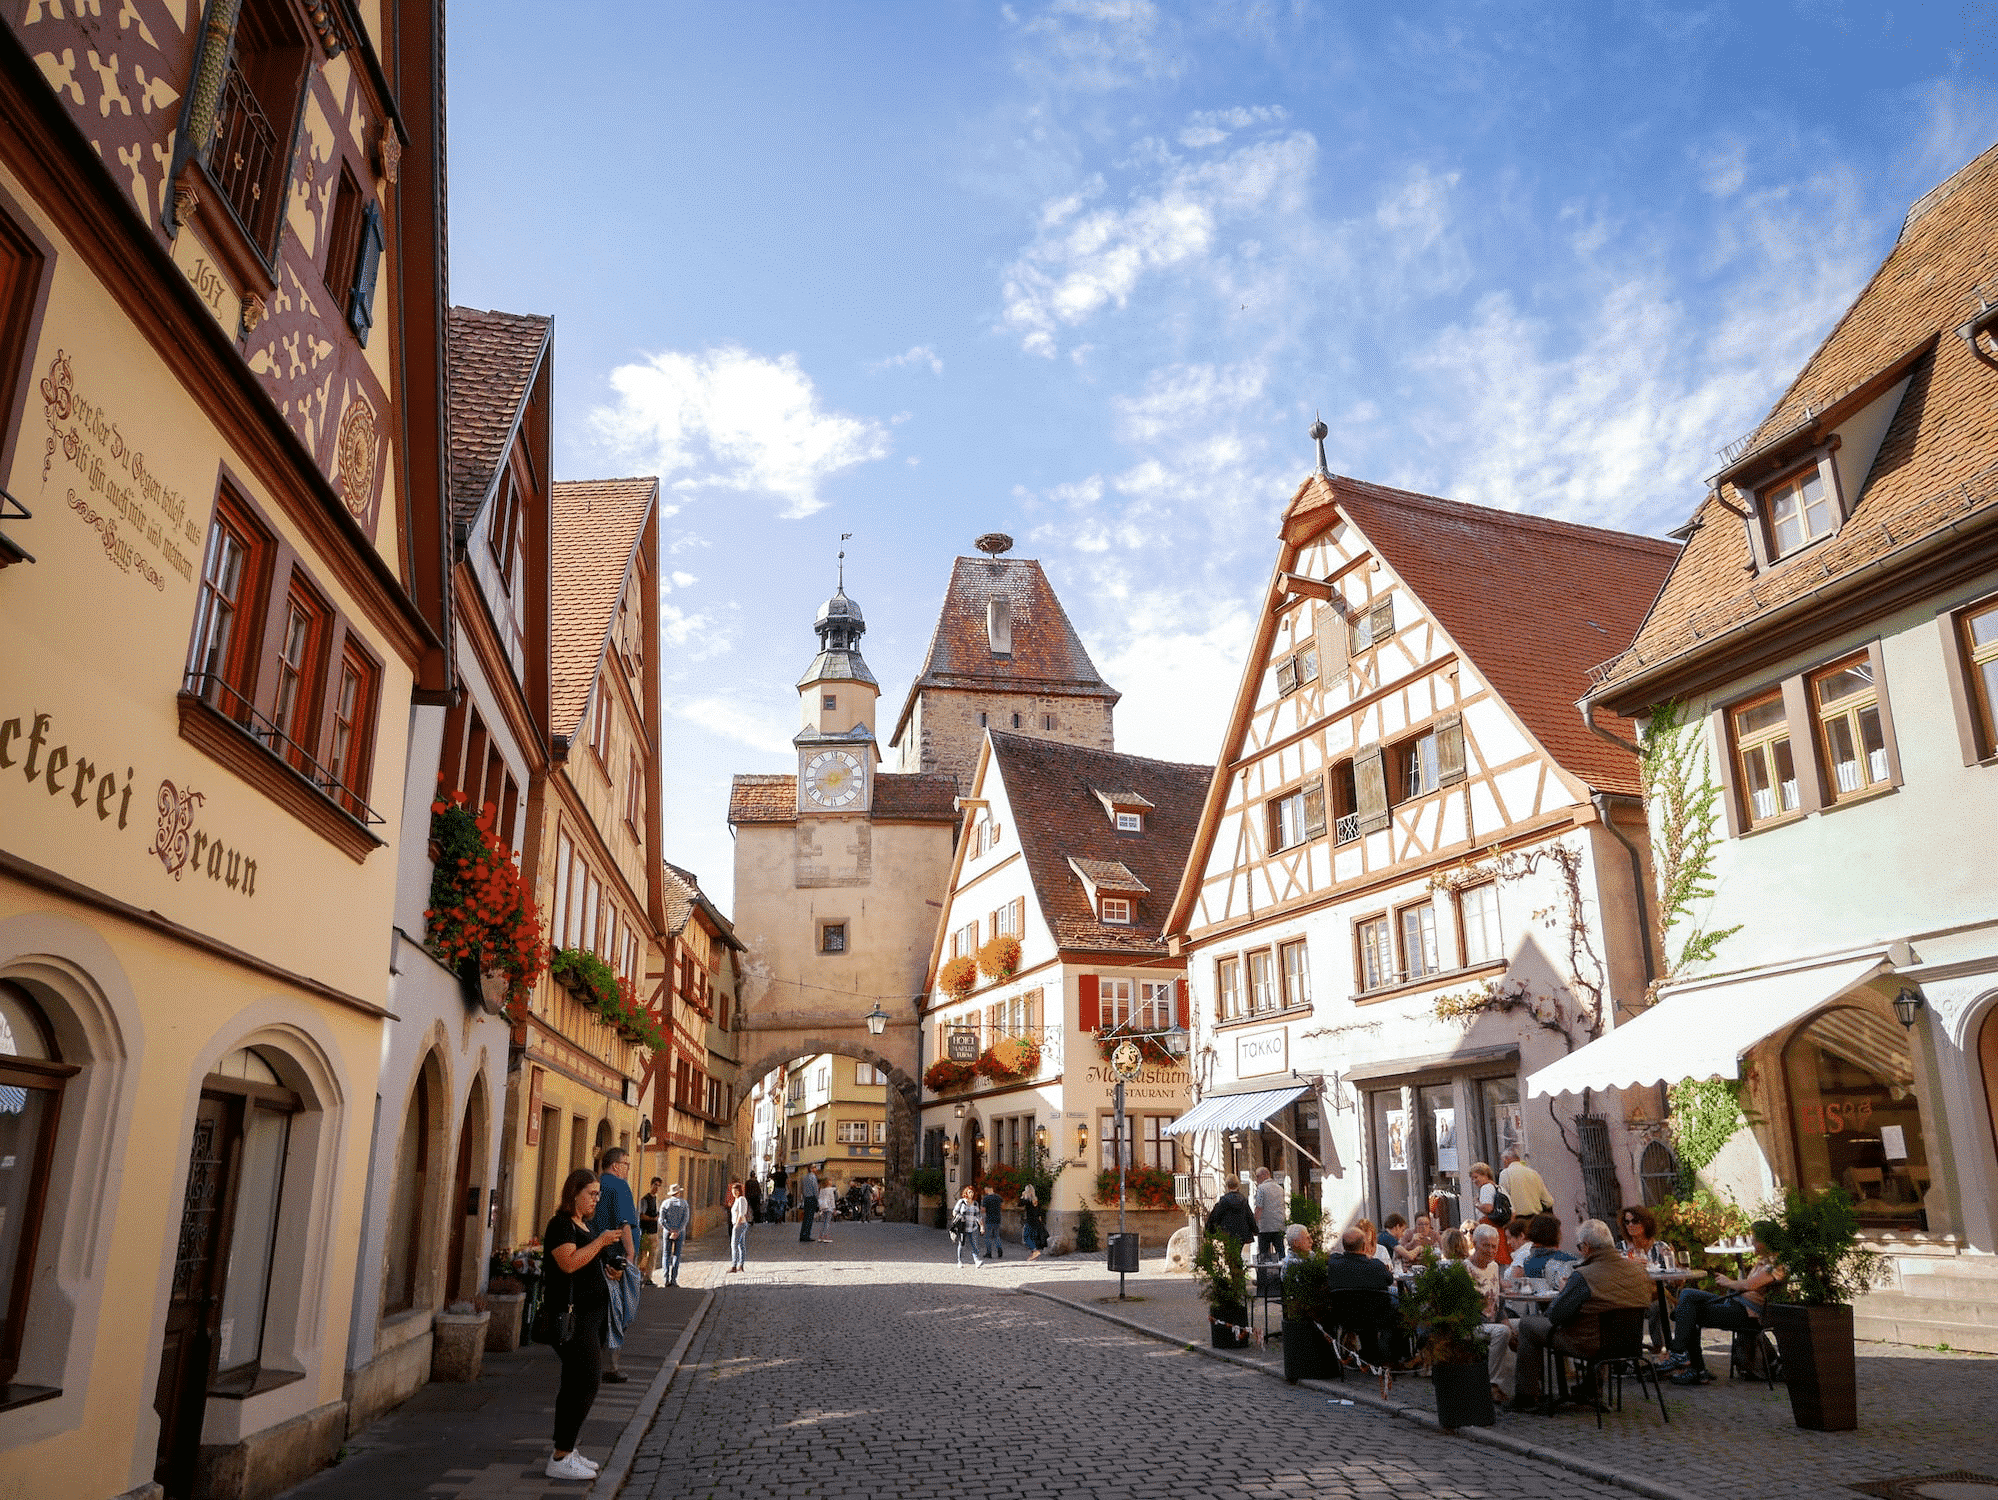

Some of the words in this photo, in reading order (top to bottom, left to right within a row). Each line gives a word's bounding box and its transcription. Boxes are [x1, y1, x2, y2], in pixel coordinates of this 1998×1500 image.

[187, 258, 225, 309] 1617
[92, 406, 110, 447] der
[111, 422, 130, 470] Du
[185, 519, 201, 547] aus
[148, 779, 258, 898] Braun
[1105, 1088, 1175, 1098] RSTAURANT
